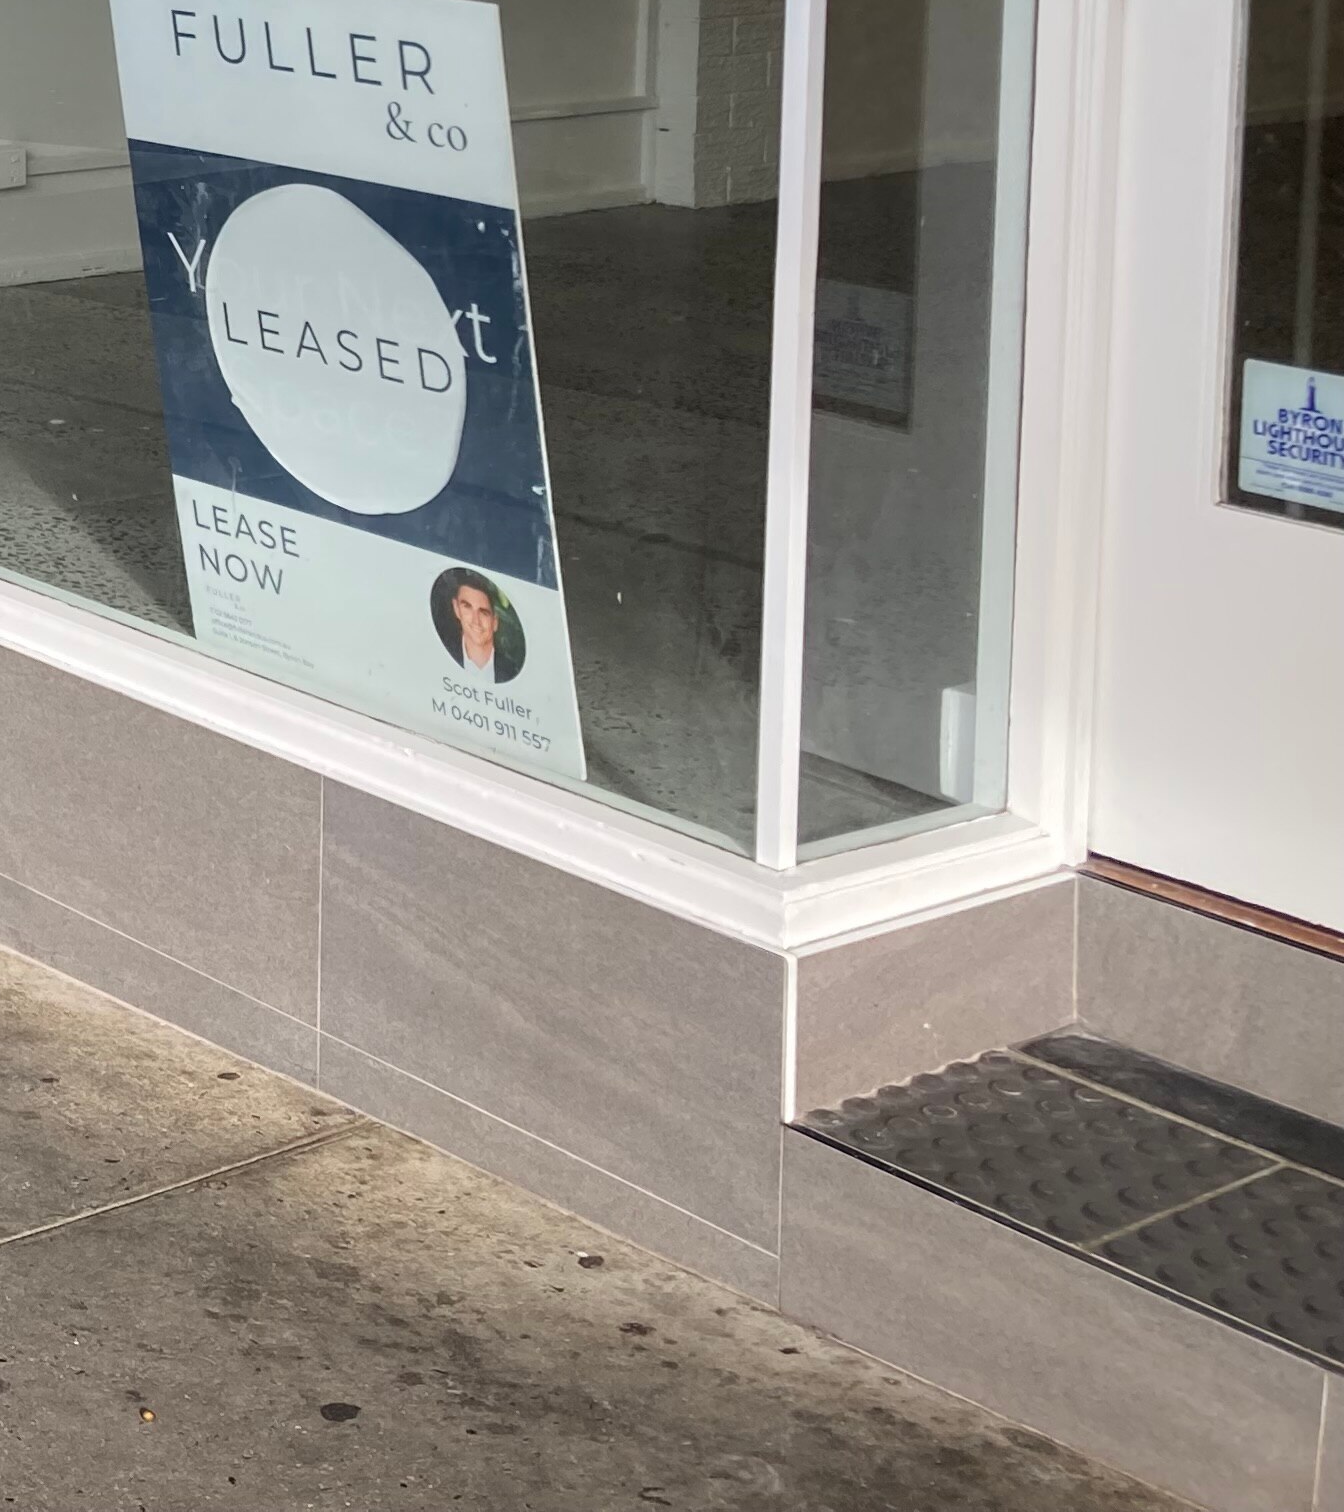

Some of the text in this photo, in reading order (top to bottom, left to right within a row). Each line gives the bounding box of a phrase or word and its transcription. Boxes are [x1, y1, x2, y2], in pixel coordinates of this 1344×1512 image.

[170, 9, 435, 95] FULLER
[386, 102, 468, 152] & co
[221, 300, 454, 395] LEASED
[1278, 408, 1343, 435] BYRON
[191, 498, 300, 558] LEASE
[199, 546, 283, 596] NOW
[442, 676, 532, 720] Scot Fuller
[431, 697, 551, 752] M 0401 911 557
